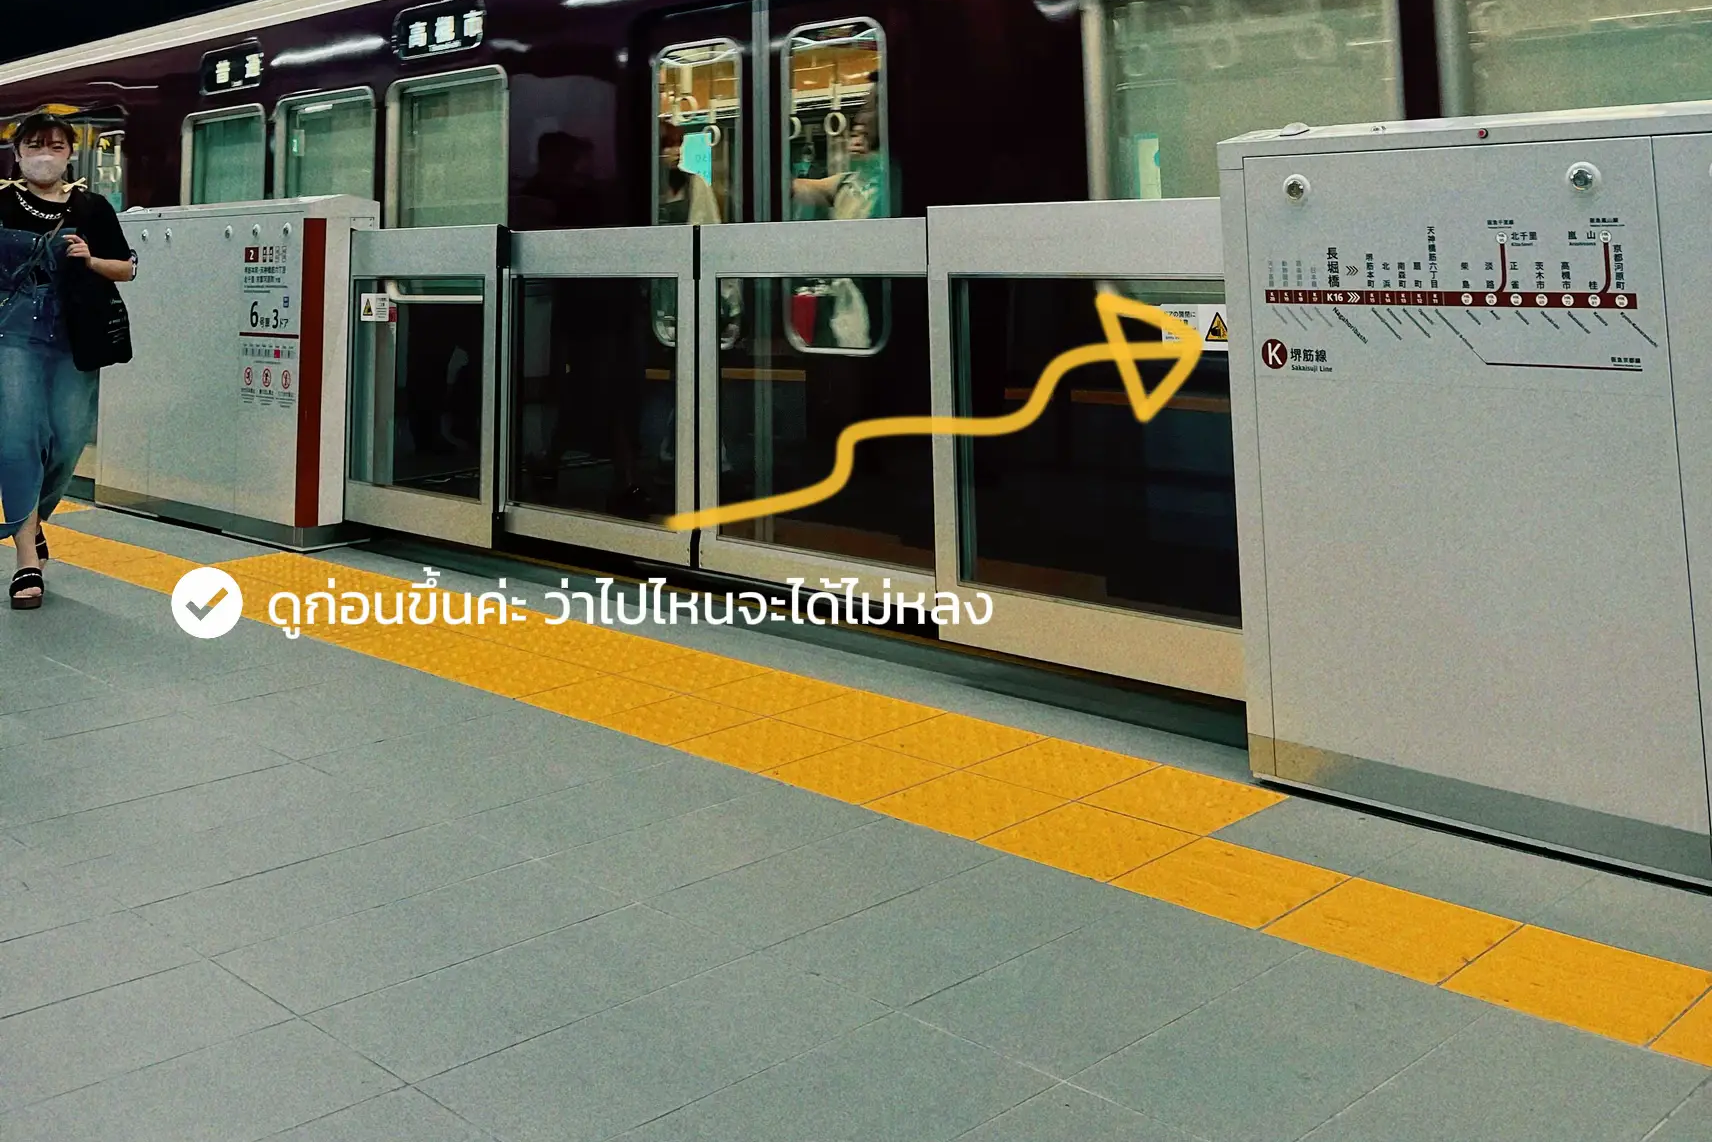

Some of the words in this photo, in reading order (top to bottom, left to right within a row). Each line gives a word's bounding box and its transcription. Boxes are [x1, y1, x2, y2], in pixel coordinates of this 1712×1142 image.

[1511, 231, 1537, 241] 北千里
[1326, 247, 1340, 287] 長堀橋
[1589, 280, 1598, 290] 桂
[1326, 293, 1343, 302] K16
[1267, 342, 1283, 365] K
[1290, 348, 1327, 362] 堺筋線
[1291, 364, 1318, 372] Sakaisuji
